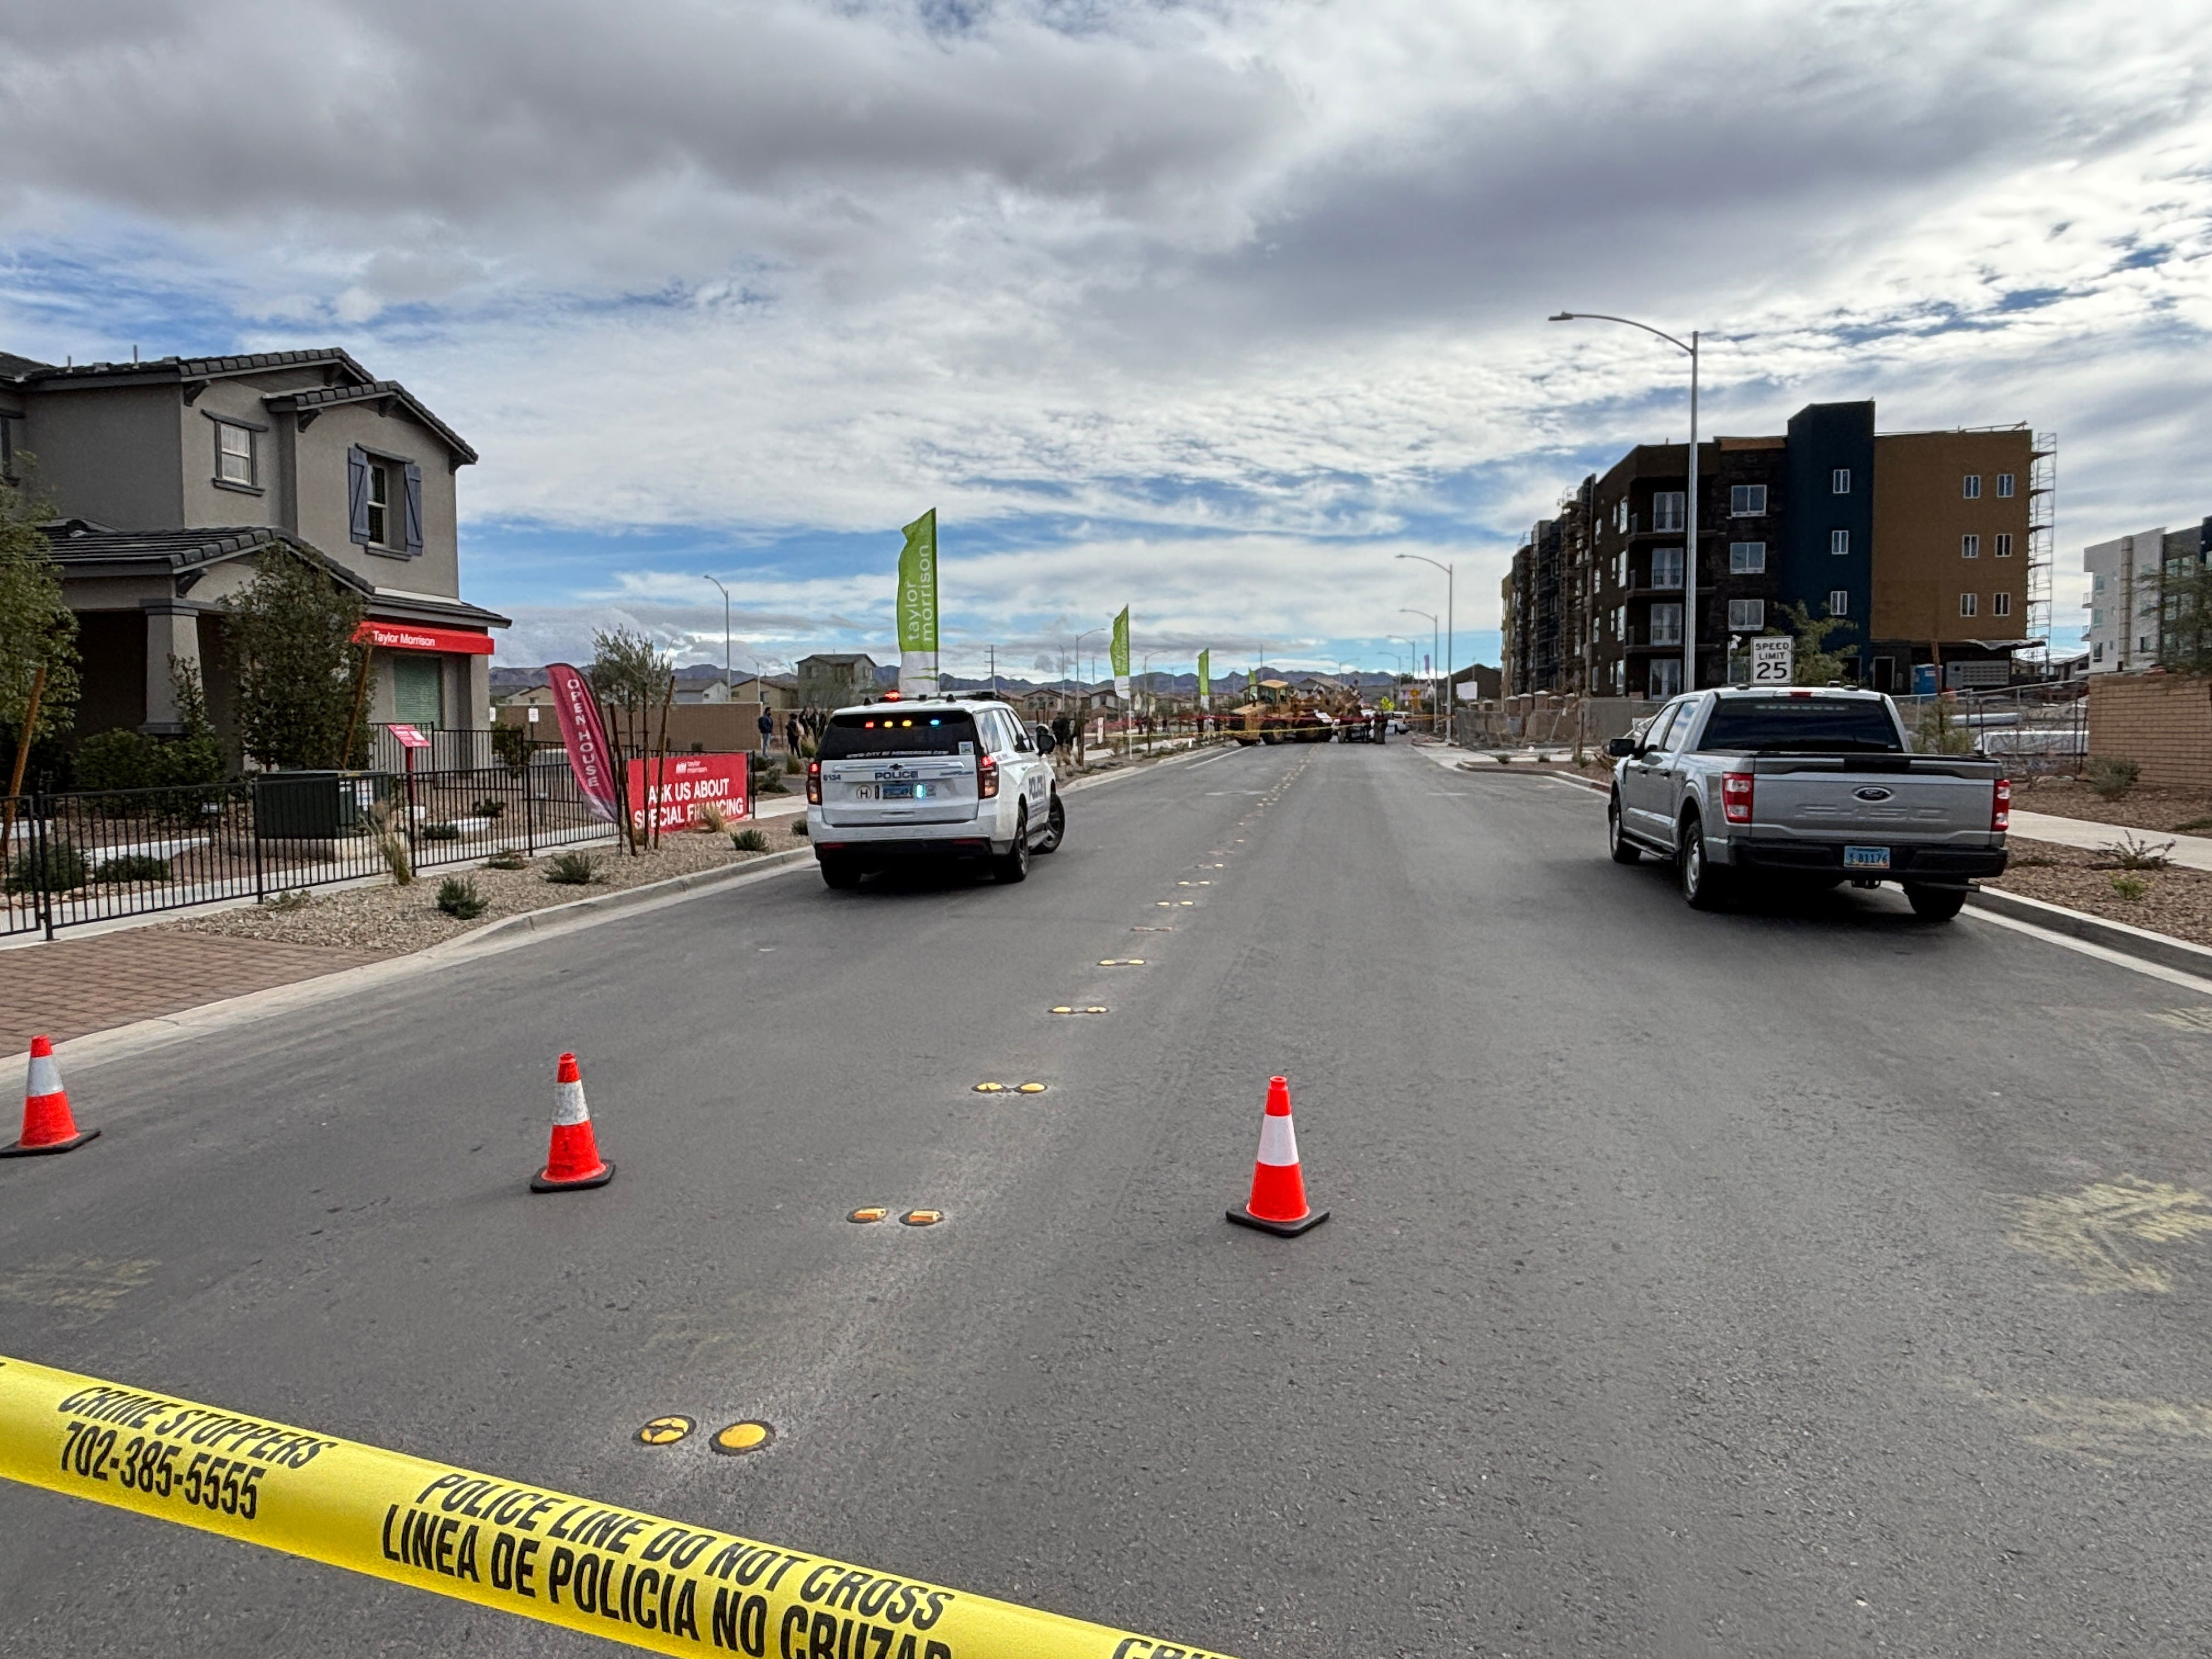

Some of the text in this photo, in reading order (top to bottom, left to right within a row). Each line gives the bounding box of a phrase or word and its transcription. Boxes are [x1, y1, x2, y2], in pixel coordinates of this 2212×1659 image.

[906, 580, 922, 642] taylor
[919, 544, 933, 642] morrison
[373, 630, 436, 647] Taylor Morrison
[1755, 642, 1790, 650] SPEED
[1758, 652, 1786, 660] LIMIT
[1756, 662, 1787, 679] 25
[567, 679, 599, 788] OPEN HOUSE
[674, 782, 691, 801] US
[693, 778, 730, 799] ABOUT
[860, 788, 869, 799] H
[875, 770, 918, 780] POLICE
[57, 1386, 339, 1470] CRIME STOPPERS
[61, 1421, 268, 1520] 702-385-5555
[415, 1473, 956, 1631] POLICE LINE DO NOT CROSS
[382, 1504, 480, 1583] LINEA
[491, 1532, 542, 1598] DE
[548, 1545, 701, 1642] POLICIA
[712, 1586, 768, 1658] NO
